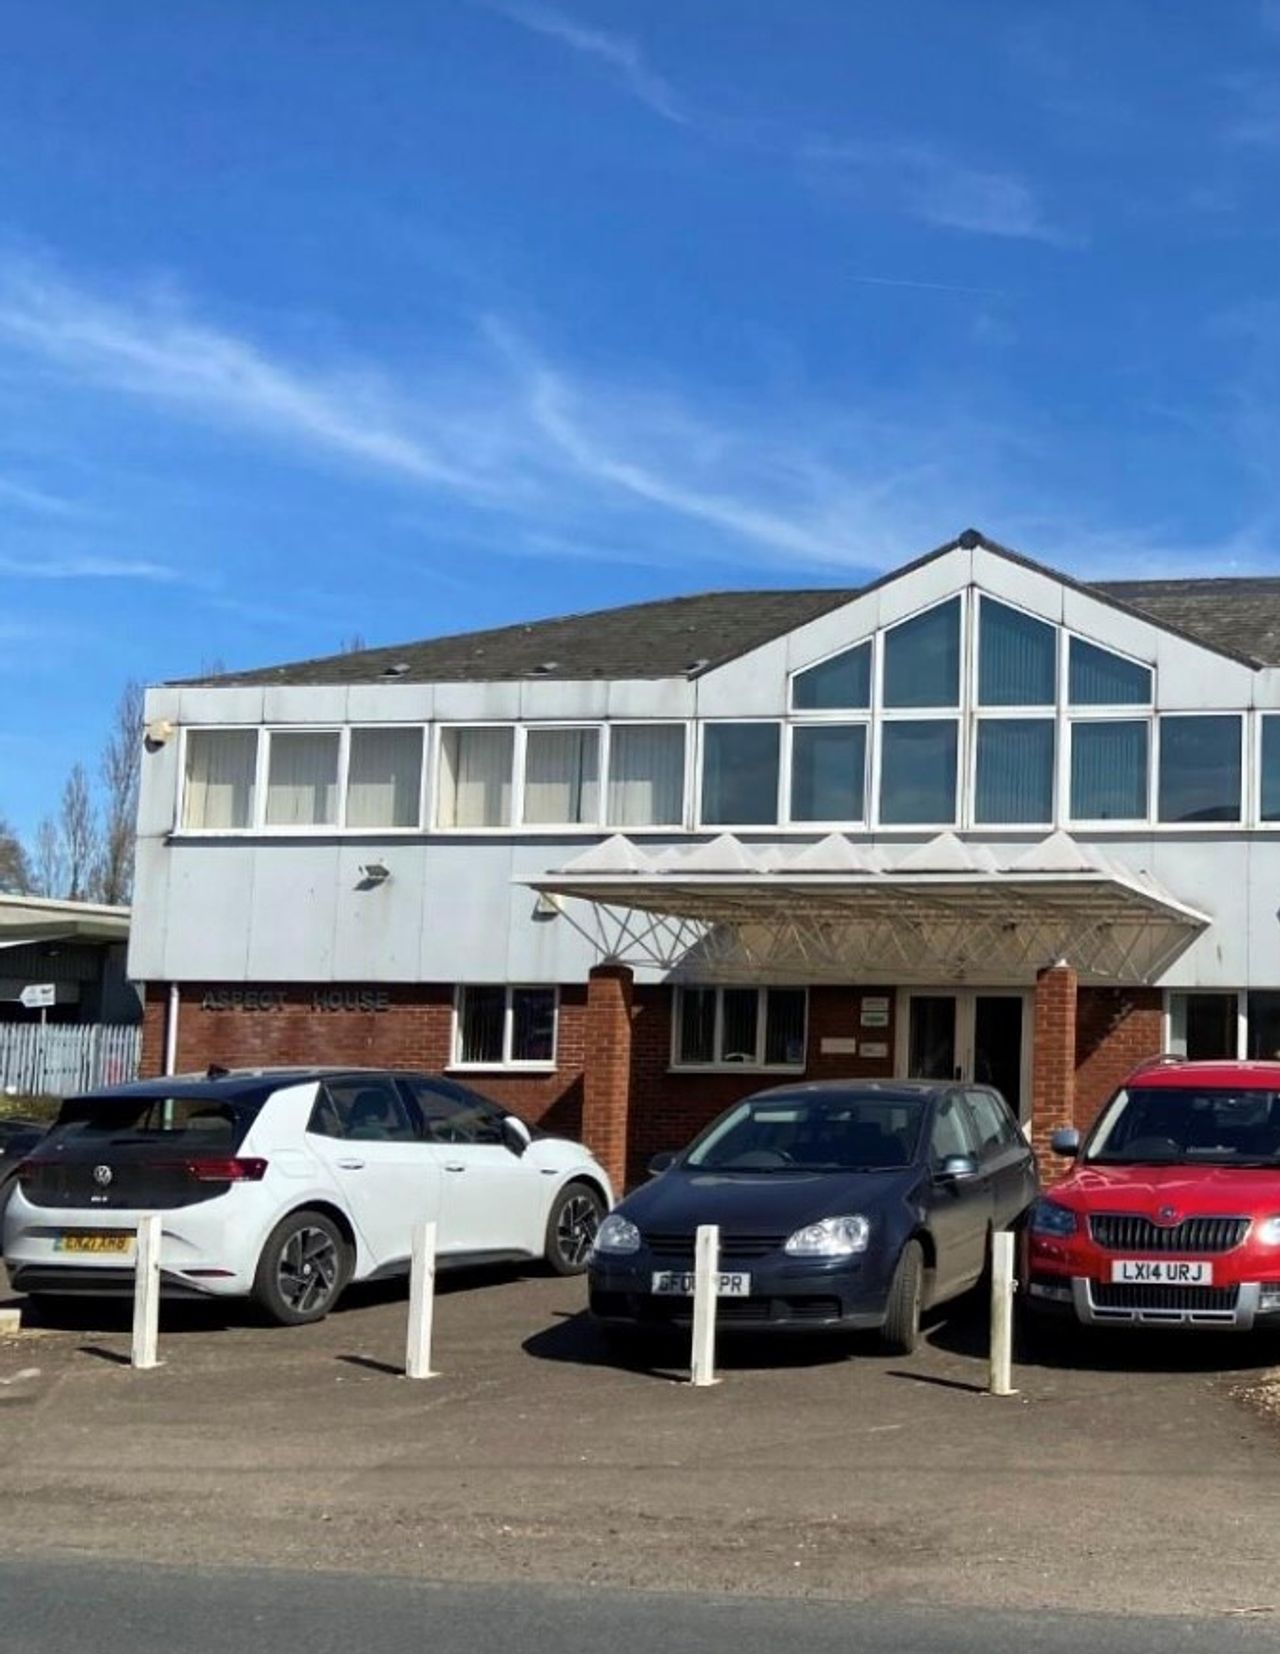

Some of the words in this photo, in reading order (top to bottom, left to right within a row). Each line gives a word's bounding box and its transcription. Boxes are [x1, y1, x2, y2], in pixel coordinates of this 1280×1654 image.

[202, 990, 288, 1009] ASPECT
[312, 990, 389, 1009] HOUSE
[1122, 1262, 1162, 1280] LX14
[1166, 1263, 1203, 1281] URJ
[659, 1275, 696, 1292] GF0
[716, 1275, 742, 1293] PR
